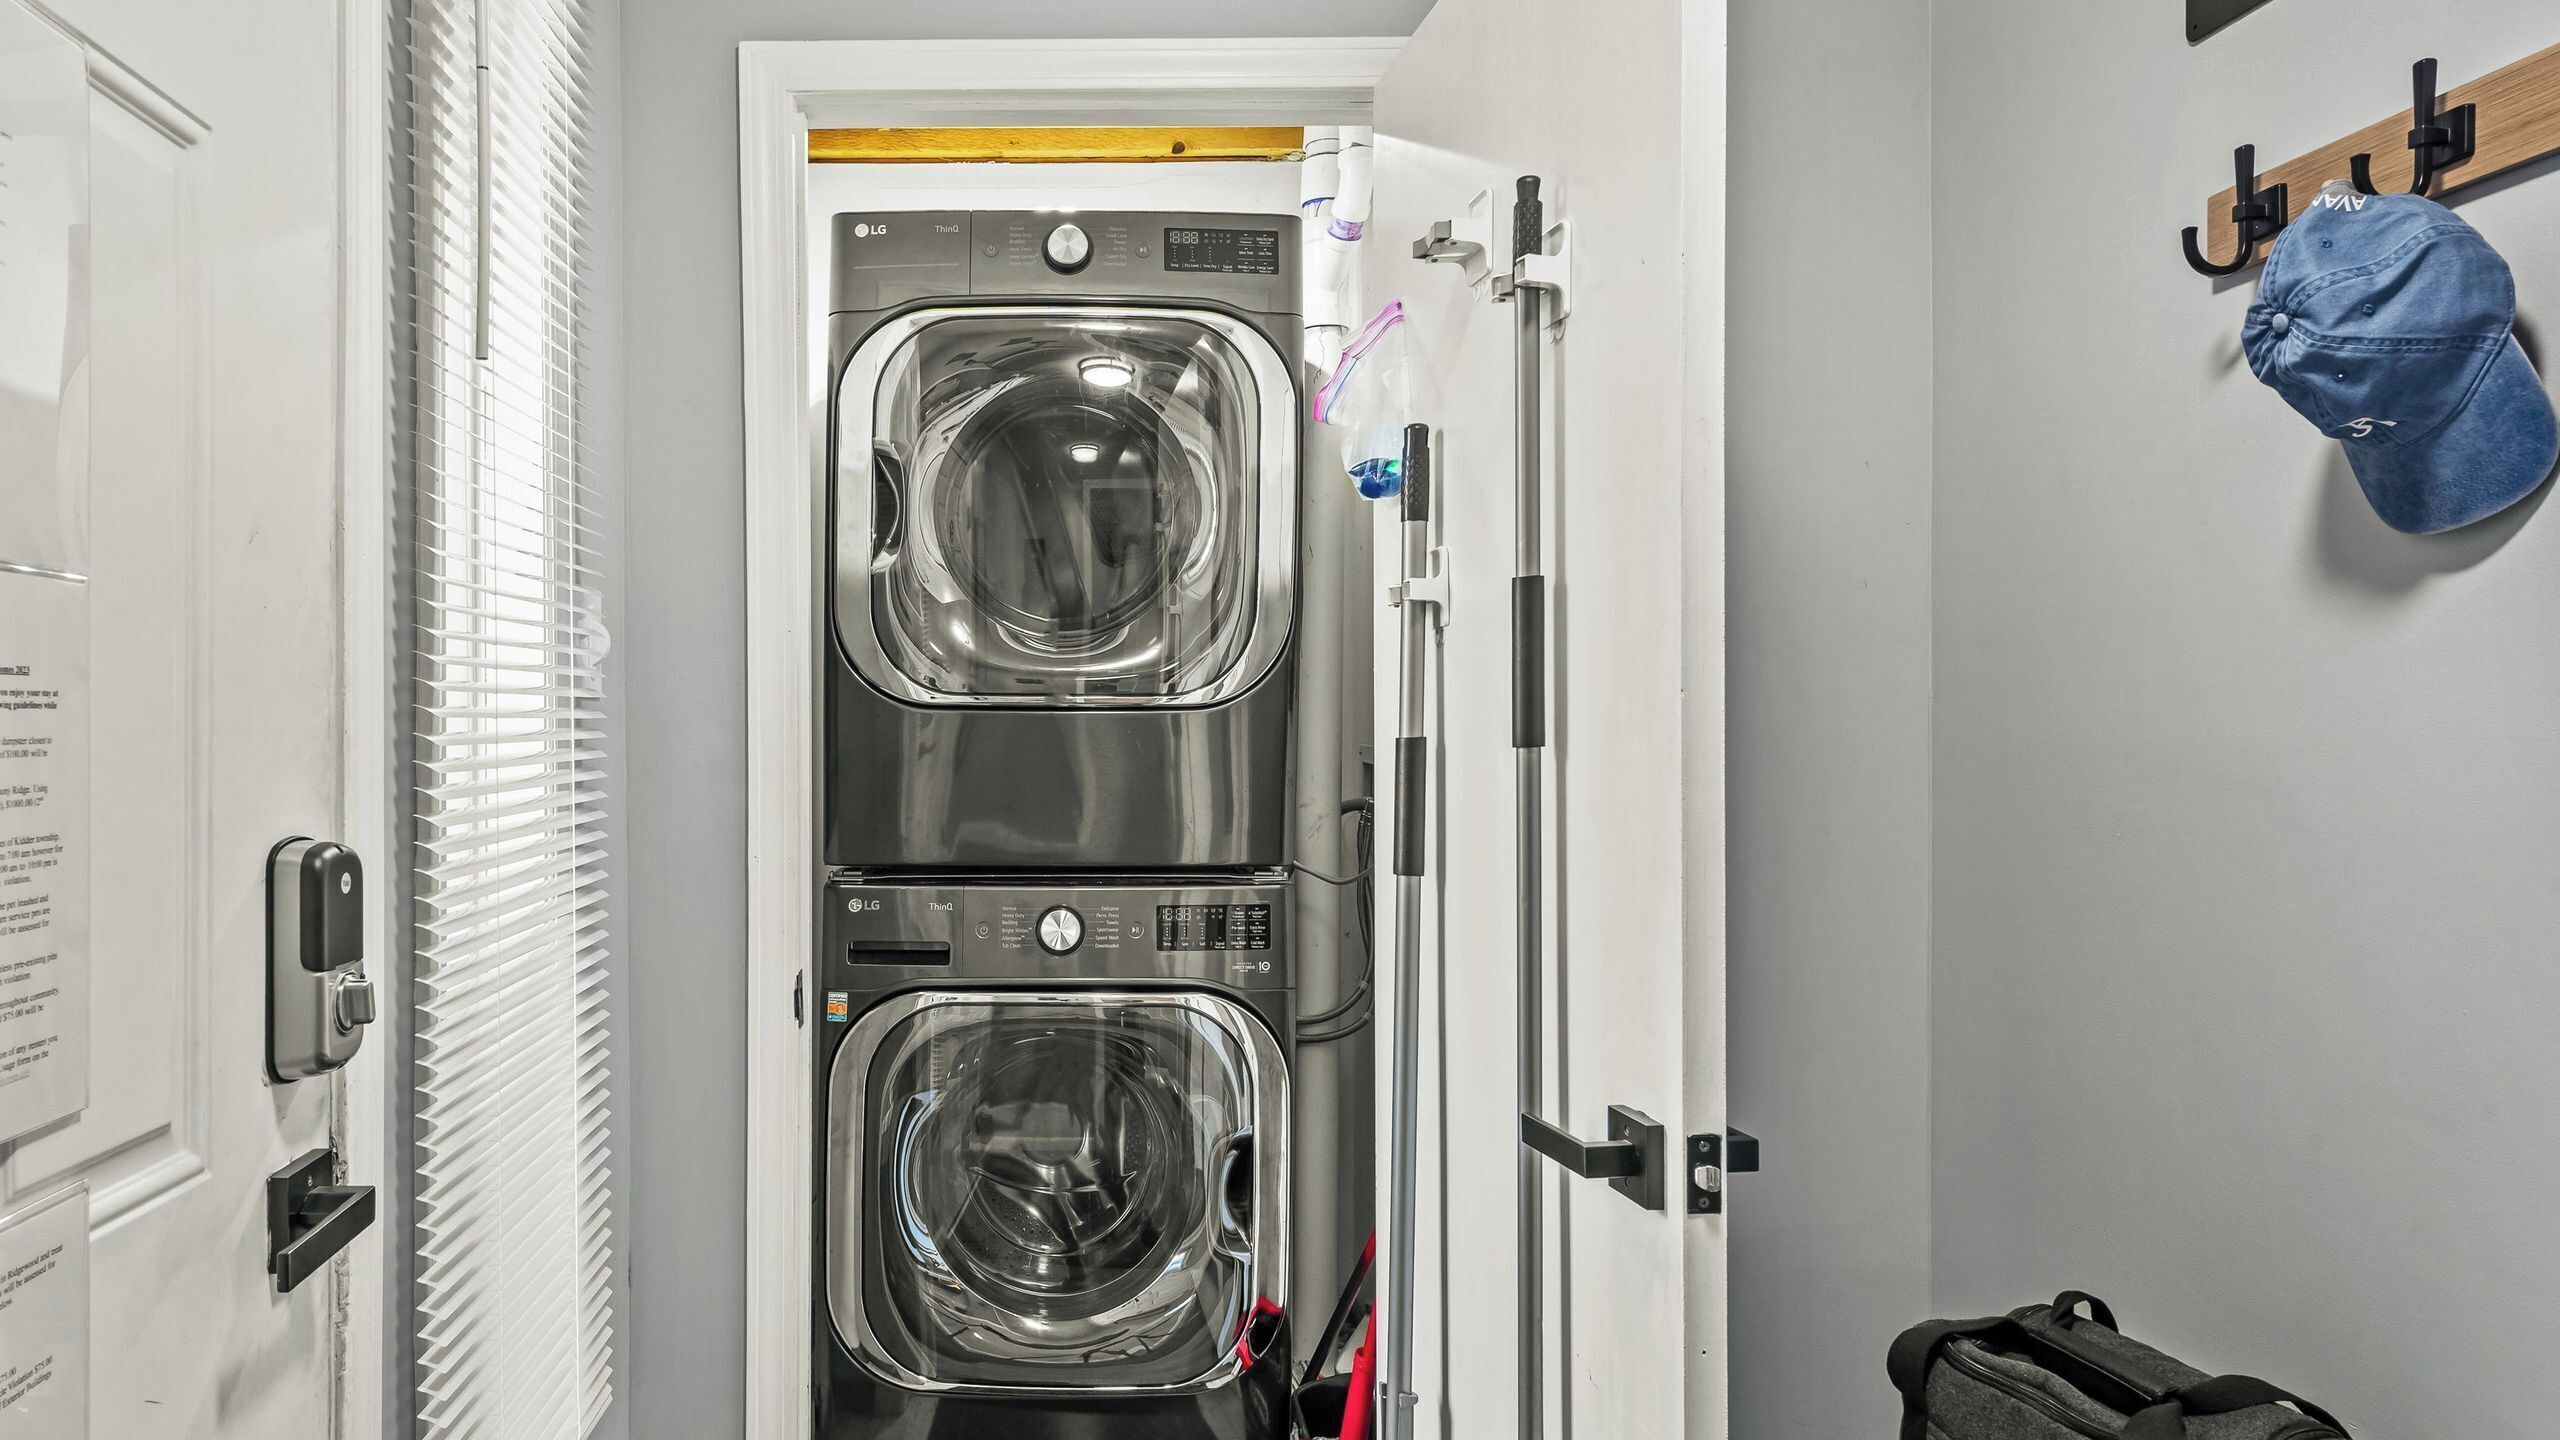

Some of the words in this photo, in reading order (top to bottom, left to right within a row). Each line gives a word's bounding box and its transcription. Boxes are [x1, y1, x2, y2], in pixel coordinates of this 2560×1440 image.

[870, 225, 887, 235] LG
[935, 224, 960, 233] ThinQ
[26, 690, 41, 698] your
[13, 701, 43, 711] guidelines
[13, 836, 35, 845] Kidder
[54, 844, 64, 853] for
[864, 900, 880, 911] LG
[928, 902, 954, 911] ThinQ
[8, 911, 31, 922] service
[25, 1004, 37, 1015] will
[47, 1035, 59, 1046] you
[7, 1256, 39, 1280] Ridgewood
[40, 1249, 51, 1262] and
[15, 1279, 23, 1288] be
[23, 1263, 47, 1284] assessed
[47, 1260, 57, 1271] for
[8, 1369, 34, 1391] Violation
[34, 1354, 53, 1374] $75.00
[3, 1387, 26, 1409] Exterior
[26, 1370, 53, 1392] Buildings
